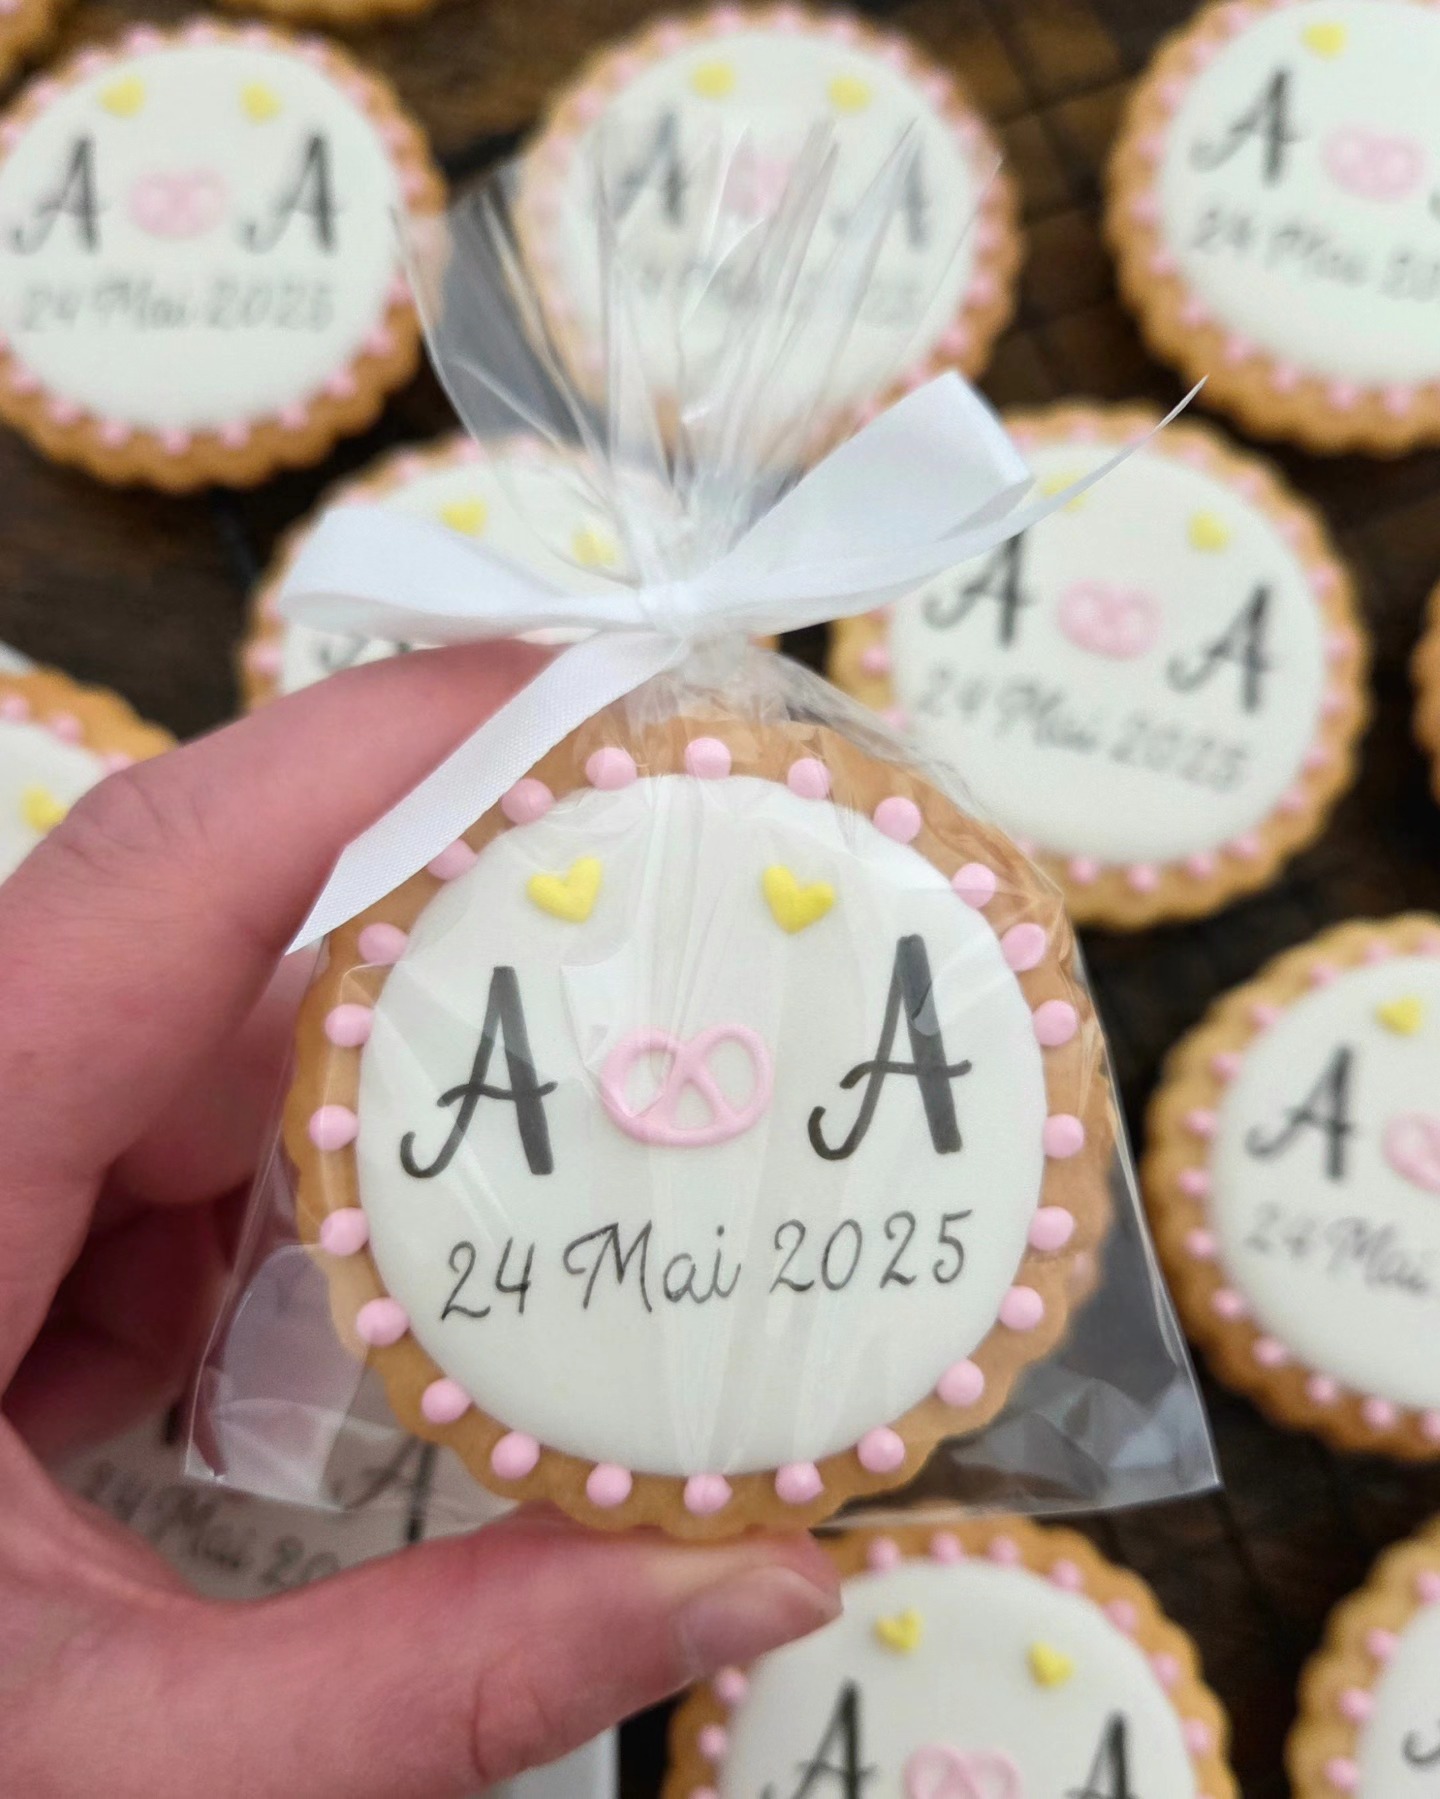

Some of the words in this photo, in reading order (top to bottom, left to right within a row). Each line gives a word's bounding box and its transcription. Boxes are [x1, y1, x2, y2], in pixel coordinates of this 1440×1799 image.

[1188, 65, 1305, 188] A
[10, 132, 110, 256] A
[240, 132, 344, 256] A
[922, 530, 1034, 650] A
[1166, 582, 1278, 714] A
[400, 966, 558, 1178] A
[808, 934, 972, 1160] A
[1246, 1043, 1357, 1182] A
[441, 1236, 536, 1320] 24
[562, 1219, 742, 1313] Mai
[769, 1209, 974, 1294] 2025
